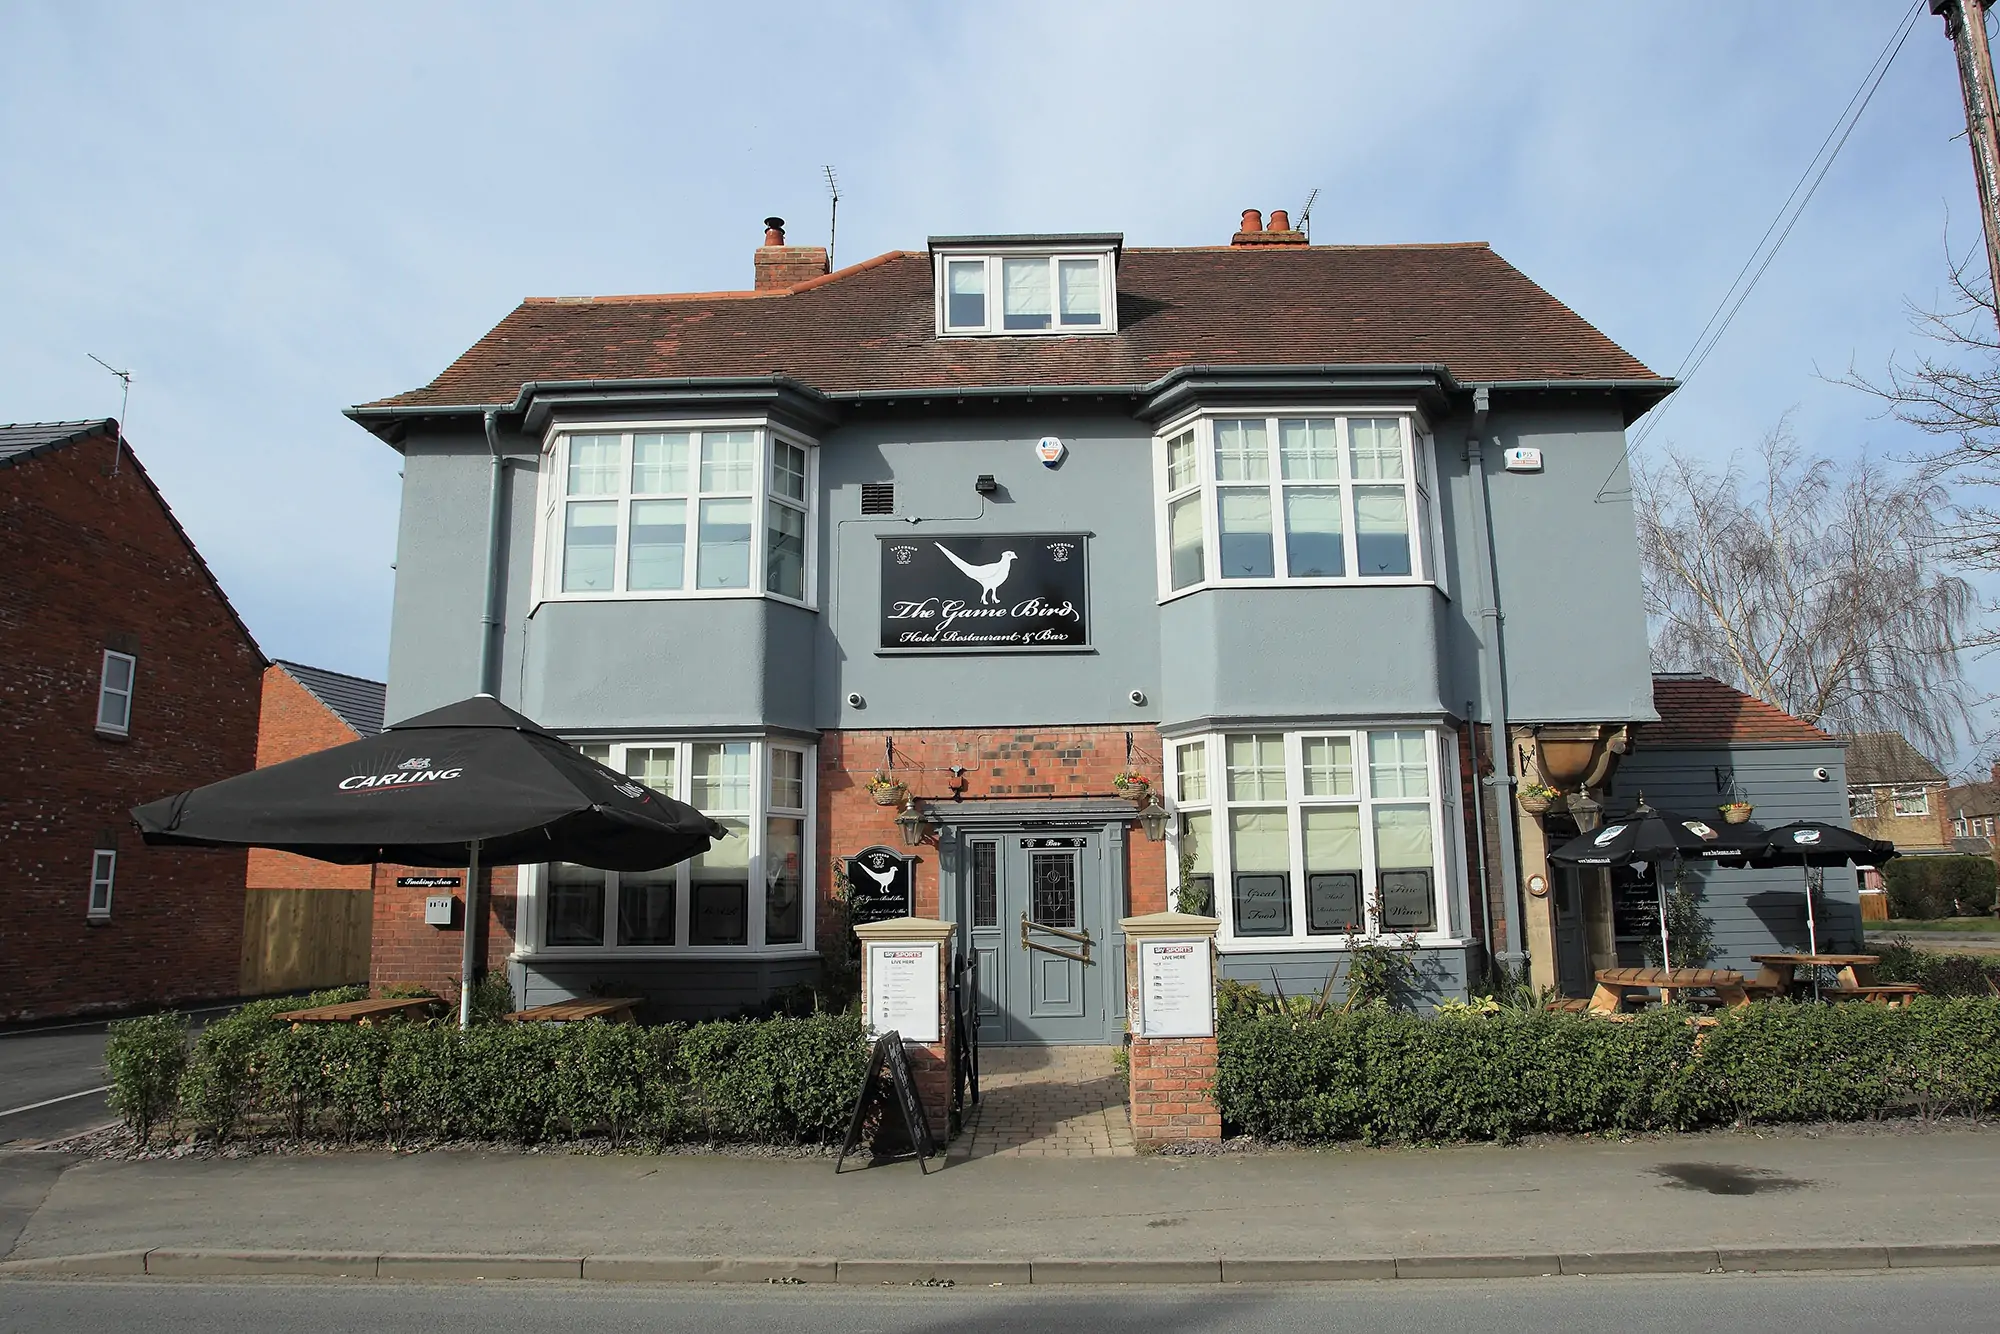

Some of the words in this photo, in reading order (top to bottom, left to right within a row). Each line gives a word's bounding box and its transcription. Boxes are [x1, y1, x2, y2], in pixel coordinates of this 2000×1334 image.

[888, 597, 939, 619] The
[935, 600, 1007, 631] Game
[1010, 597, 1080, 622] Bird
[899, 630, 938, 643] Hotel
[940, 630, 1021, 642] Restaurant
[1022, 631, 1034, 644] &
[1034, 628, 1069, 640] Bar
[338, 768, 463, 790] CARLING
[1045, 839, 1062, 847] Bar
[405, 878, 434, 887] Smoking
[1390, 883, 1421, 894] Fine
[1244, 888, 1277, 904] Great
[1247, 909, 1277, 920] Food
[1390, 905, 1423, 916] Wines
